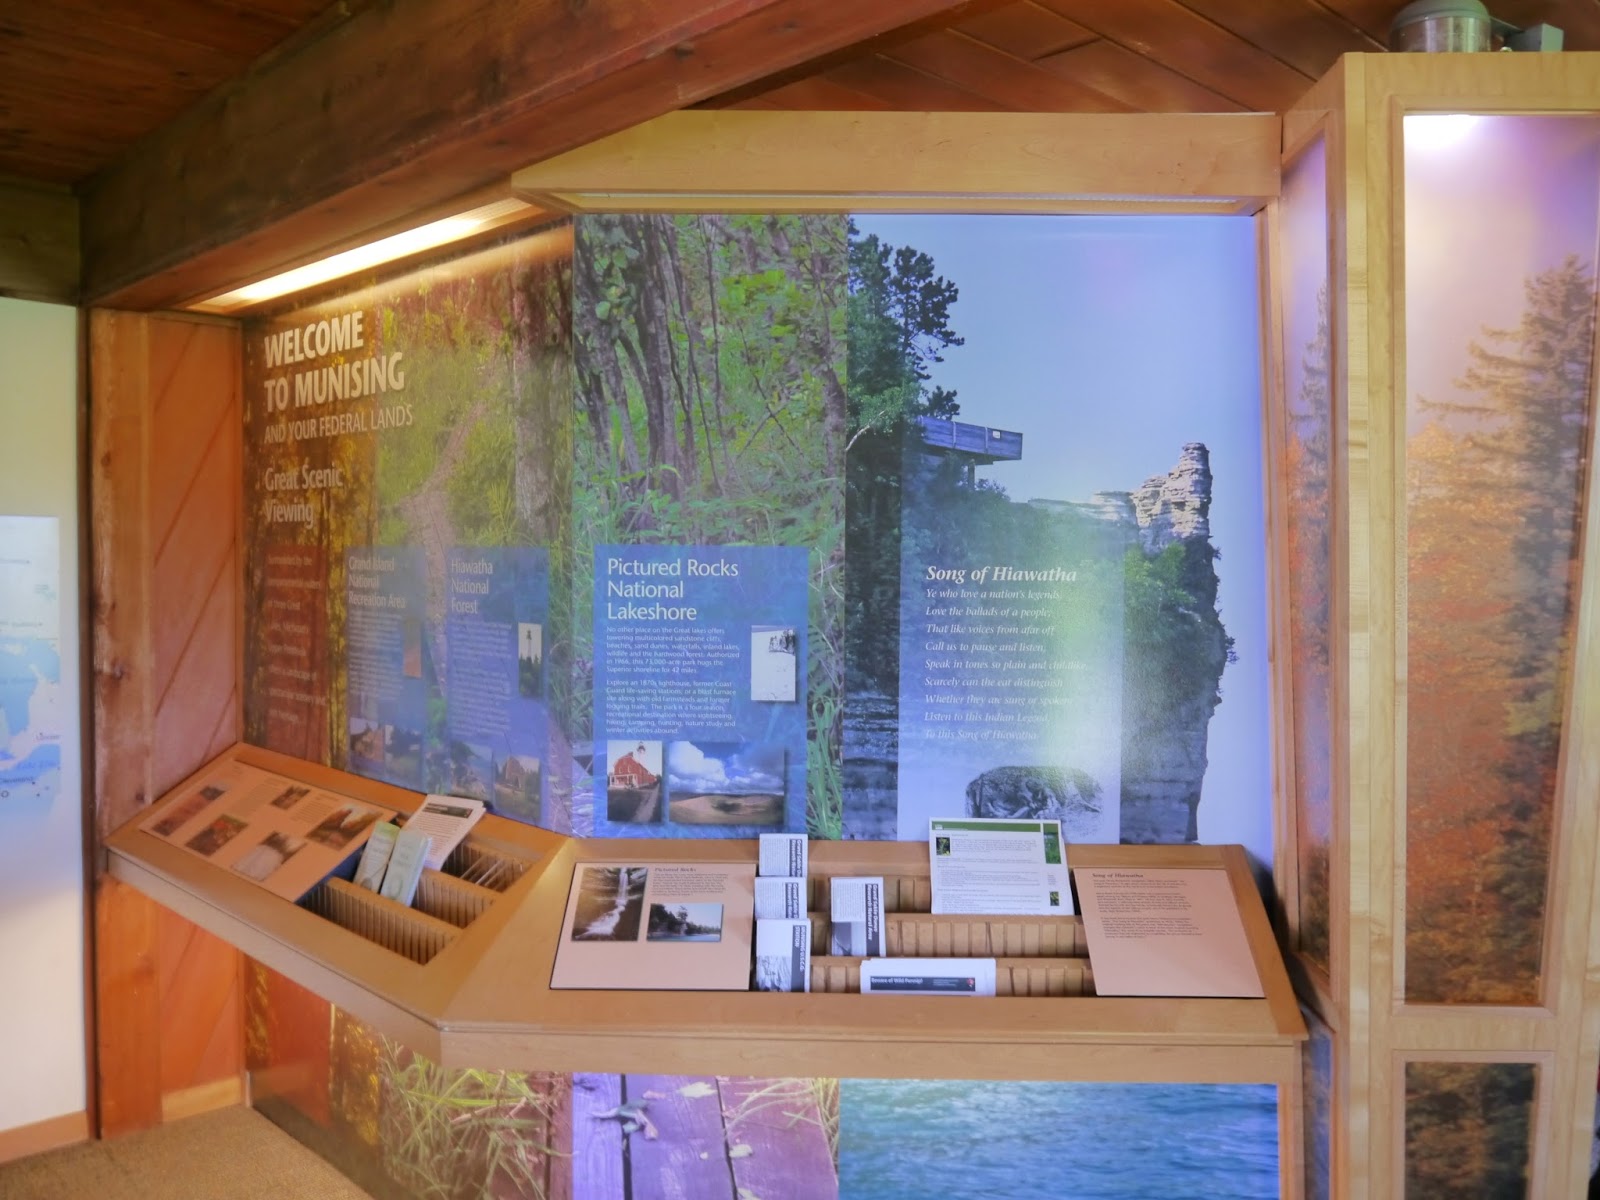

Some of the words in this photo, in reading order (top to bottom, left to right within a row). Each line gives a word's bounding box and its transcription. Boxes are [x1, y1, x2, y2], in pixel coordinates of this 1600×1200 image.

[265, 311, 363, 368] WELCOME
[264, 377, 288, 412] TO
[295, 352, 405, 407] MUNISING
[264, 424, 286, 444] AND
[288, 417, 317, 440] YOUR
[320, 412, 367, 438] FEDERAL
[370, 404, 413, 430] LANDS
[265, 467, 298, 491] Great
[302, 462, 343, 489] Scenic
[265, 500, 314, 529] Viewing
[349, 556, 371, 570] Grand
[372, 556, 394, 571] Island
[452, 557, 493, 574] Hiawatha
[608, 558, 681, 576] Pictured
[687, 559, 739, 576] Rocks
[349, 574, 380, 588] National
[926, 565, 967, 584] Song
[970, 566, 991, 584] of
[992, 566, 1077, 582] Hiawatha
[452, 578, 489, 594] National
[608, 580, 684, 598] National
[926, 588, 938, 598] Ye
[940, 588, 958, 598] who
[960, 589, 978, 598] love
[989, 590, 1025, 599] nation's
[349, 591, 386, 608] Recreation
[388, 593, 407, 608] Area
[452, 597, 478, 614] Forest
[608, 602, 697, 620] Lakeshore
[926, 606, 947, 616] Love
[949, 606, 964, 616] the
[966, 606, 998, 616] ballads
[1000, 608, 1010, 618] of
[926, 624, 949, 634] That
[950, 624, 966, 634] like
[968, 625, 994, 634] voices
[996, 625, 1019, 636] from
[1021, 626, 1040, 636] afar
[926, 641, 944, 651] Call
[946, 644, 958, 652] us
[960, 642, 969, 652] to
[970, 644, 997, 654] pause
[1000, 643, 1018, 652] and
[924, 659, 951, 670] Speak
[954, 660, 963, 669] in
[965, 660, 988, 669] tones
[1003, 660, 1026, 671] plain
[1028, 660, 1047, 670] and
[924, 676, 960, 688] Scarcely
[980, 678, 996, 686] the
[925, 694, 964, 704] Whether
[924, 712, 951, 721] Listen
[954, 712, 963, 721] to
[966, 712, 982, 721] this
[985, 712, 1015, 722] Indian
